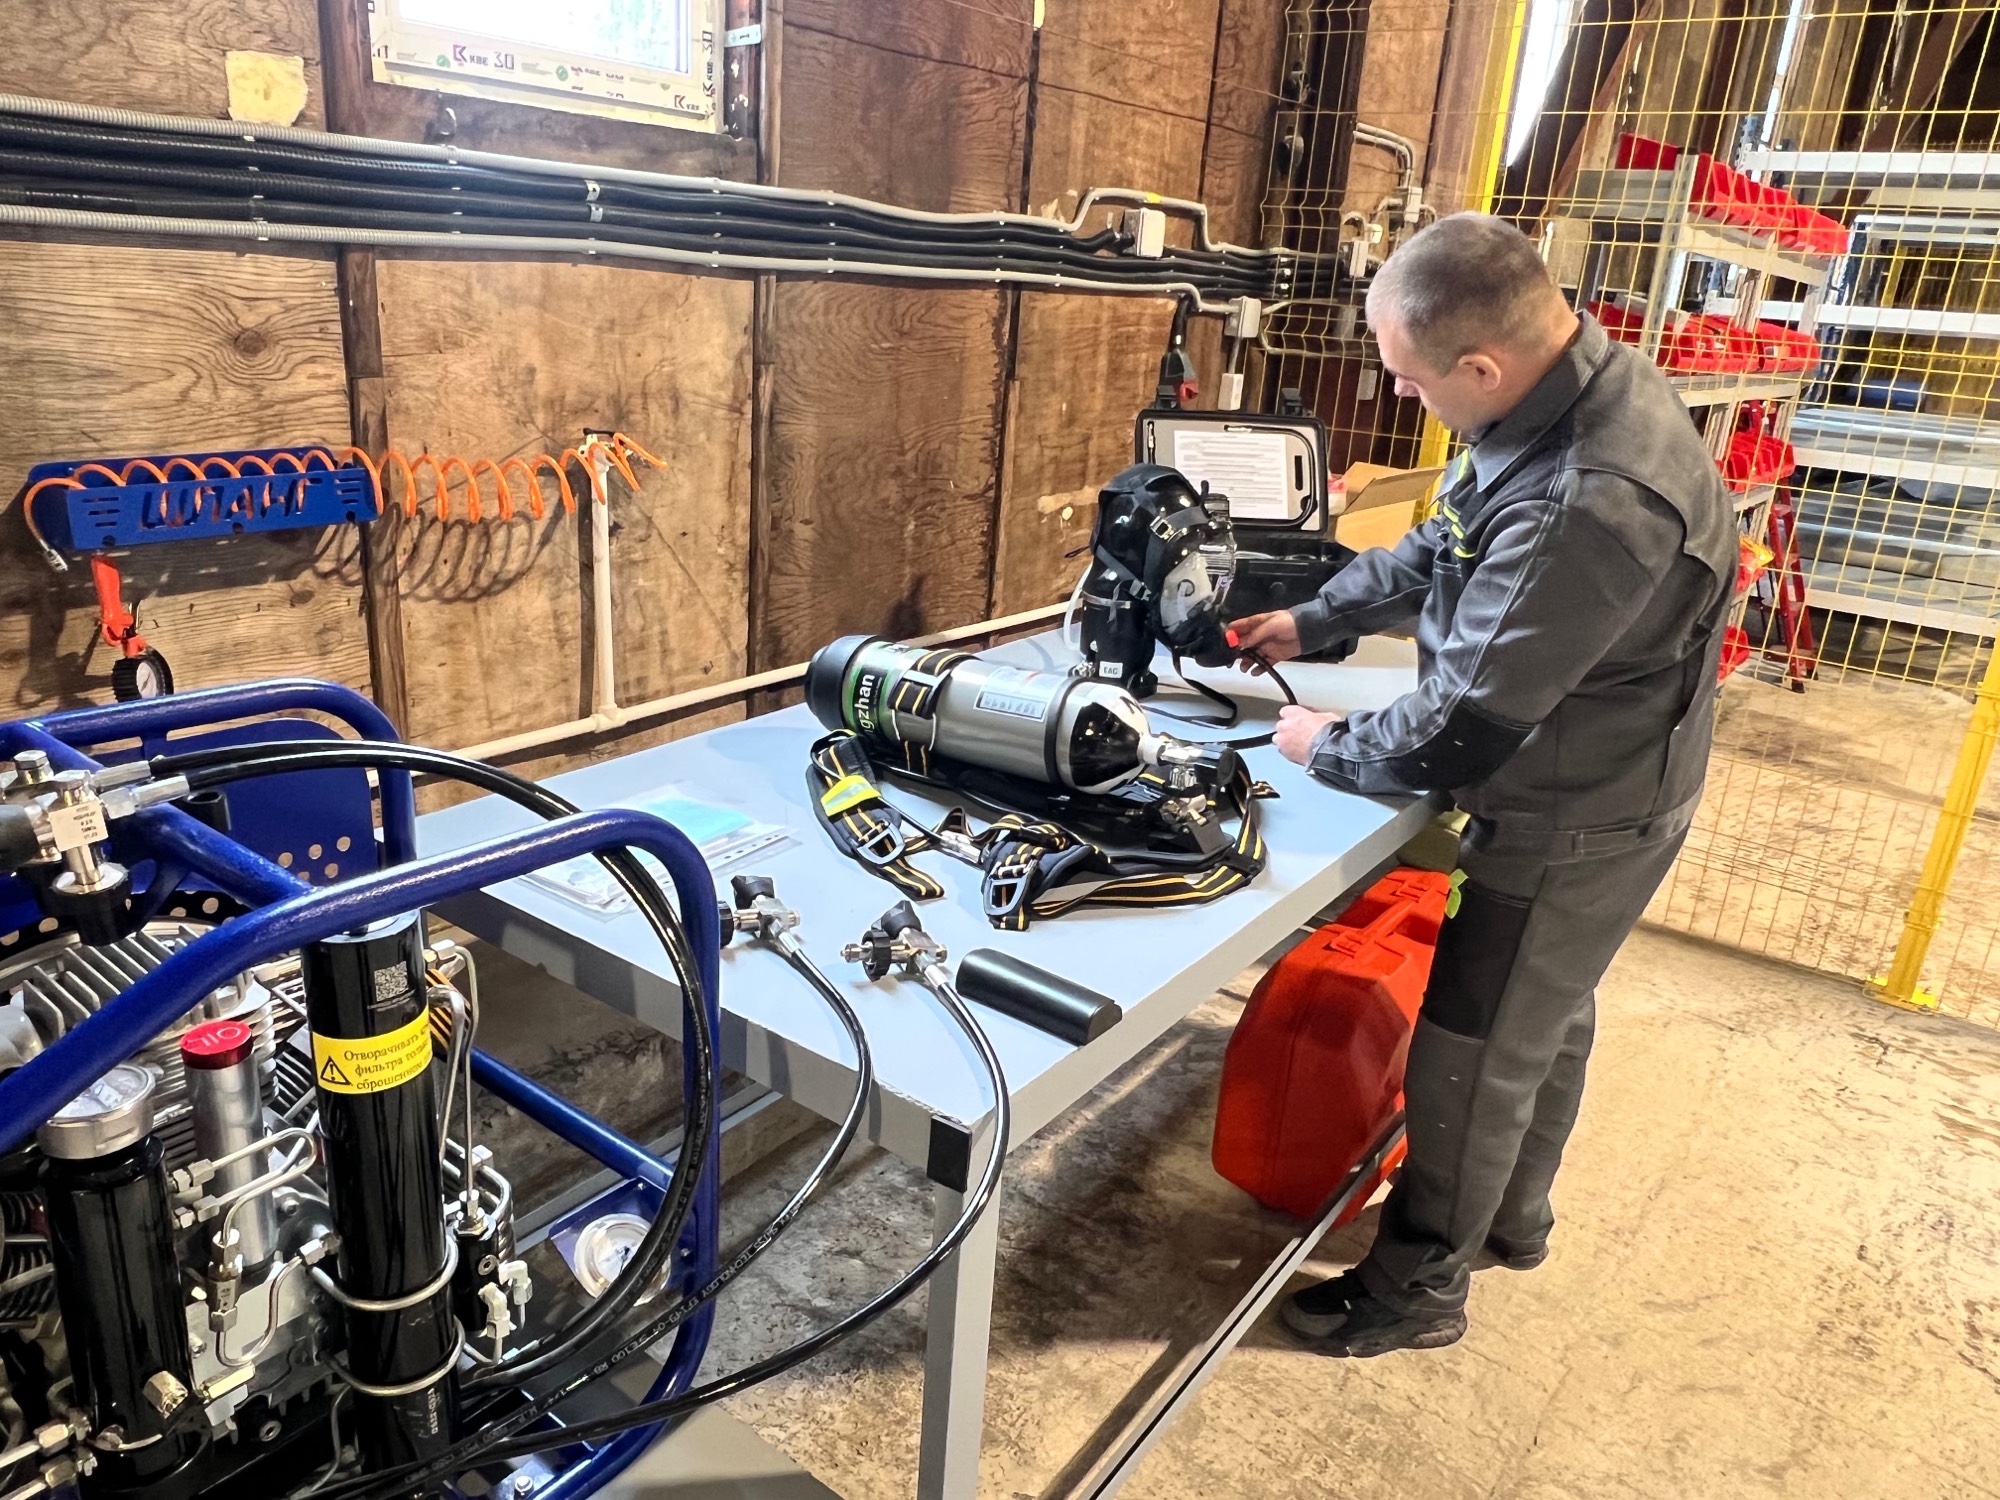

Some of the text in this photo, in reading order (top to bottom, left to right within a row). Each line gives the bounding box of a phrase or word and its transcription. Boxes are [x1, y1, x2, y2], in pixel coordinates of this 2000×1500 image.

[469, 54, 489, 66] KBE
[186, 1026, 242, 1047] OIL
[343, 1033, 419, 1061] Отворачивать
[355, 1057, 403, 1078] фильтра
[702, 1250, 752, 1298] TECHNOLOGY
